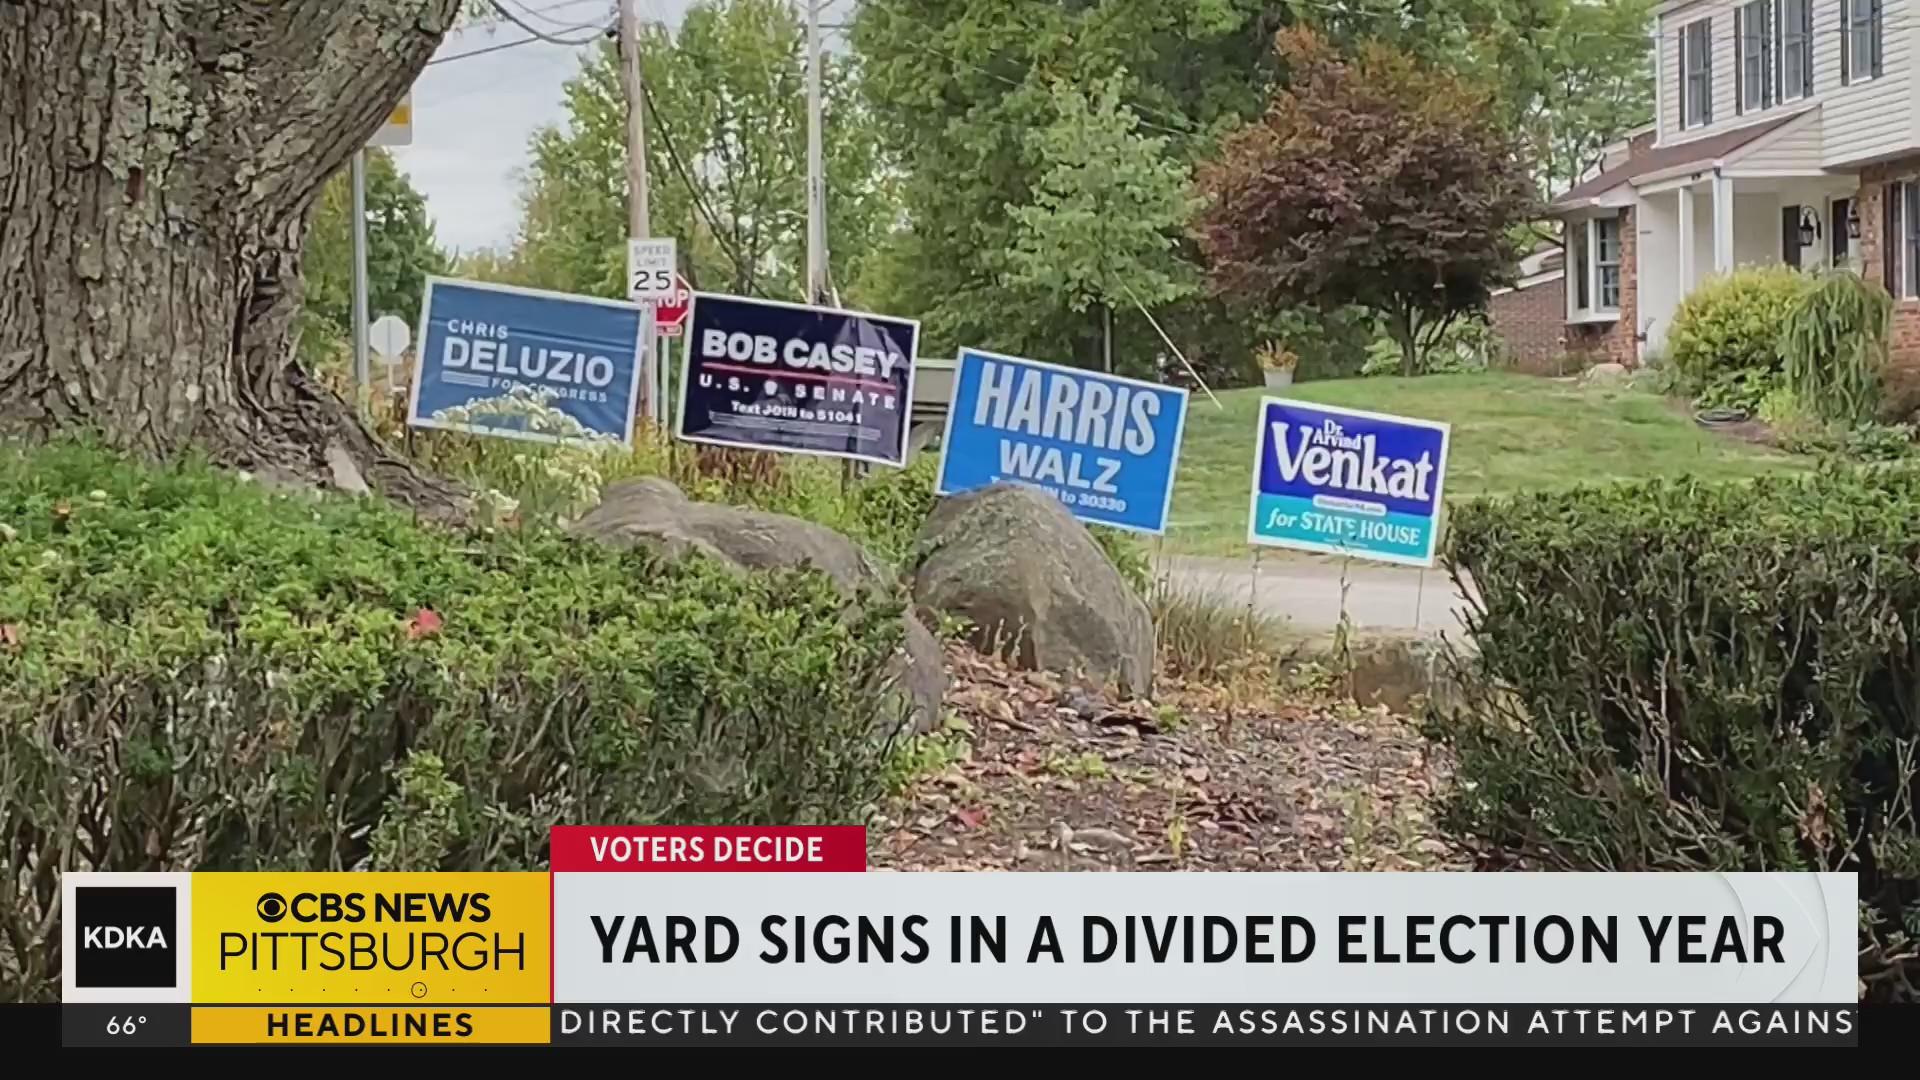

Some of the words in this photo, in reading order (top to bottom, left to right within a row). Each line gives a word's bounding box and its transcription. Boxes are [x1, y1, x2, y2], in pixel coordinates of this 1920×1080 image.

[633, 245, 671, 255] SPEED
[637, 257, 666, 267] LIMIT
[634, 270, 671, 290] 25
[657, 289, 688, 308] OP
[447, 319, 509, 339] CHRIS
[442, 336, 614, 387] DELUZIO
[702, 328, 777, 364] BOB
[783, 338, 898, 379] CASEY
[491, 376, 519, 391] FO
[529, 382, 607, 403] COGRESS
[699, 373, 750, 393] U.S.
[795, 384, 896, 410] SENATE
[731, 401, 760, 415] Text
[762, 406, 797, 418] JOIN
[800, 408, 815, 420] to
[817, 410, 862, 424] 51041
[974, 361, 1160, 456] HARRIS
[1312, 427, 1362, 450] Arvind
[1324, 418, 1344, 436] Dr.
[1001, 439, 1121, 494] WALZ
[1271, 421, 1433, 501] Venkat
[1061, 490, 1077, 504] to
[1078, 492, 1127, 513] 30330
[1266, 507, 1297, 529] for
[1300, 511, 1356, 537] STATE
[1361, 520, 1421, 546] HOUSE
